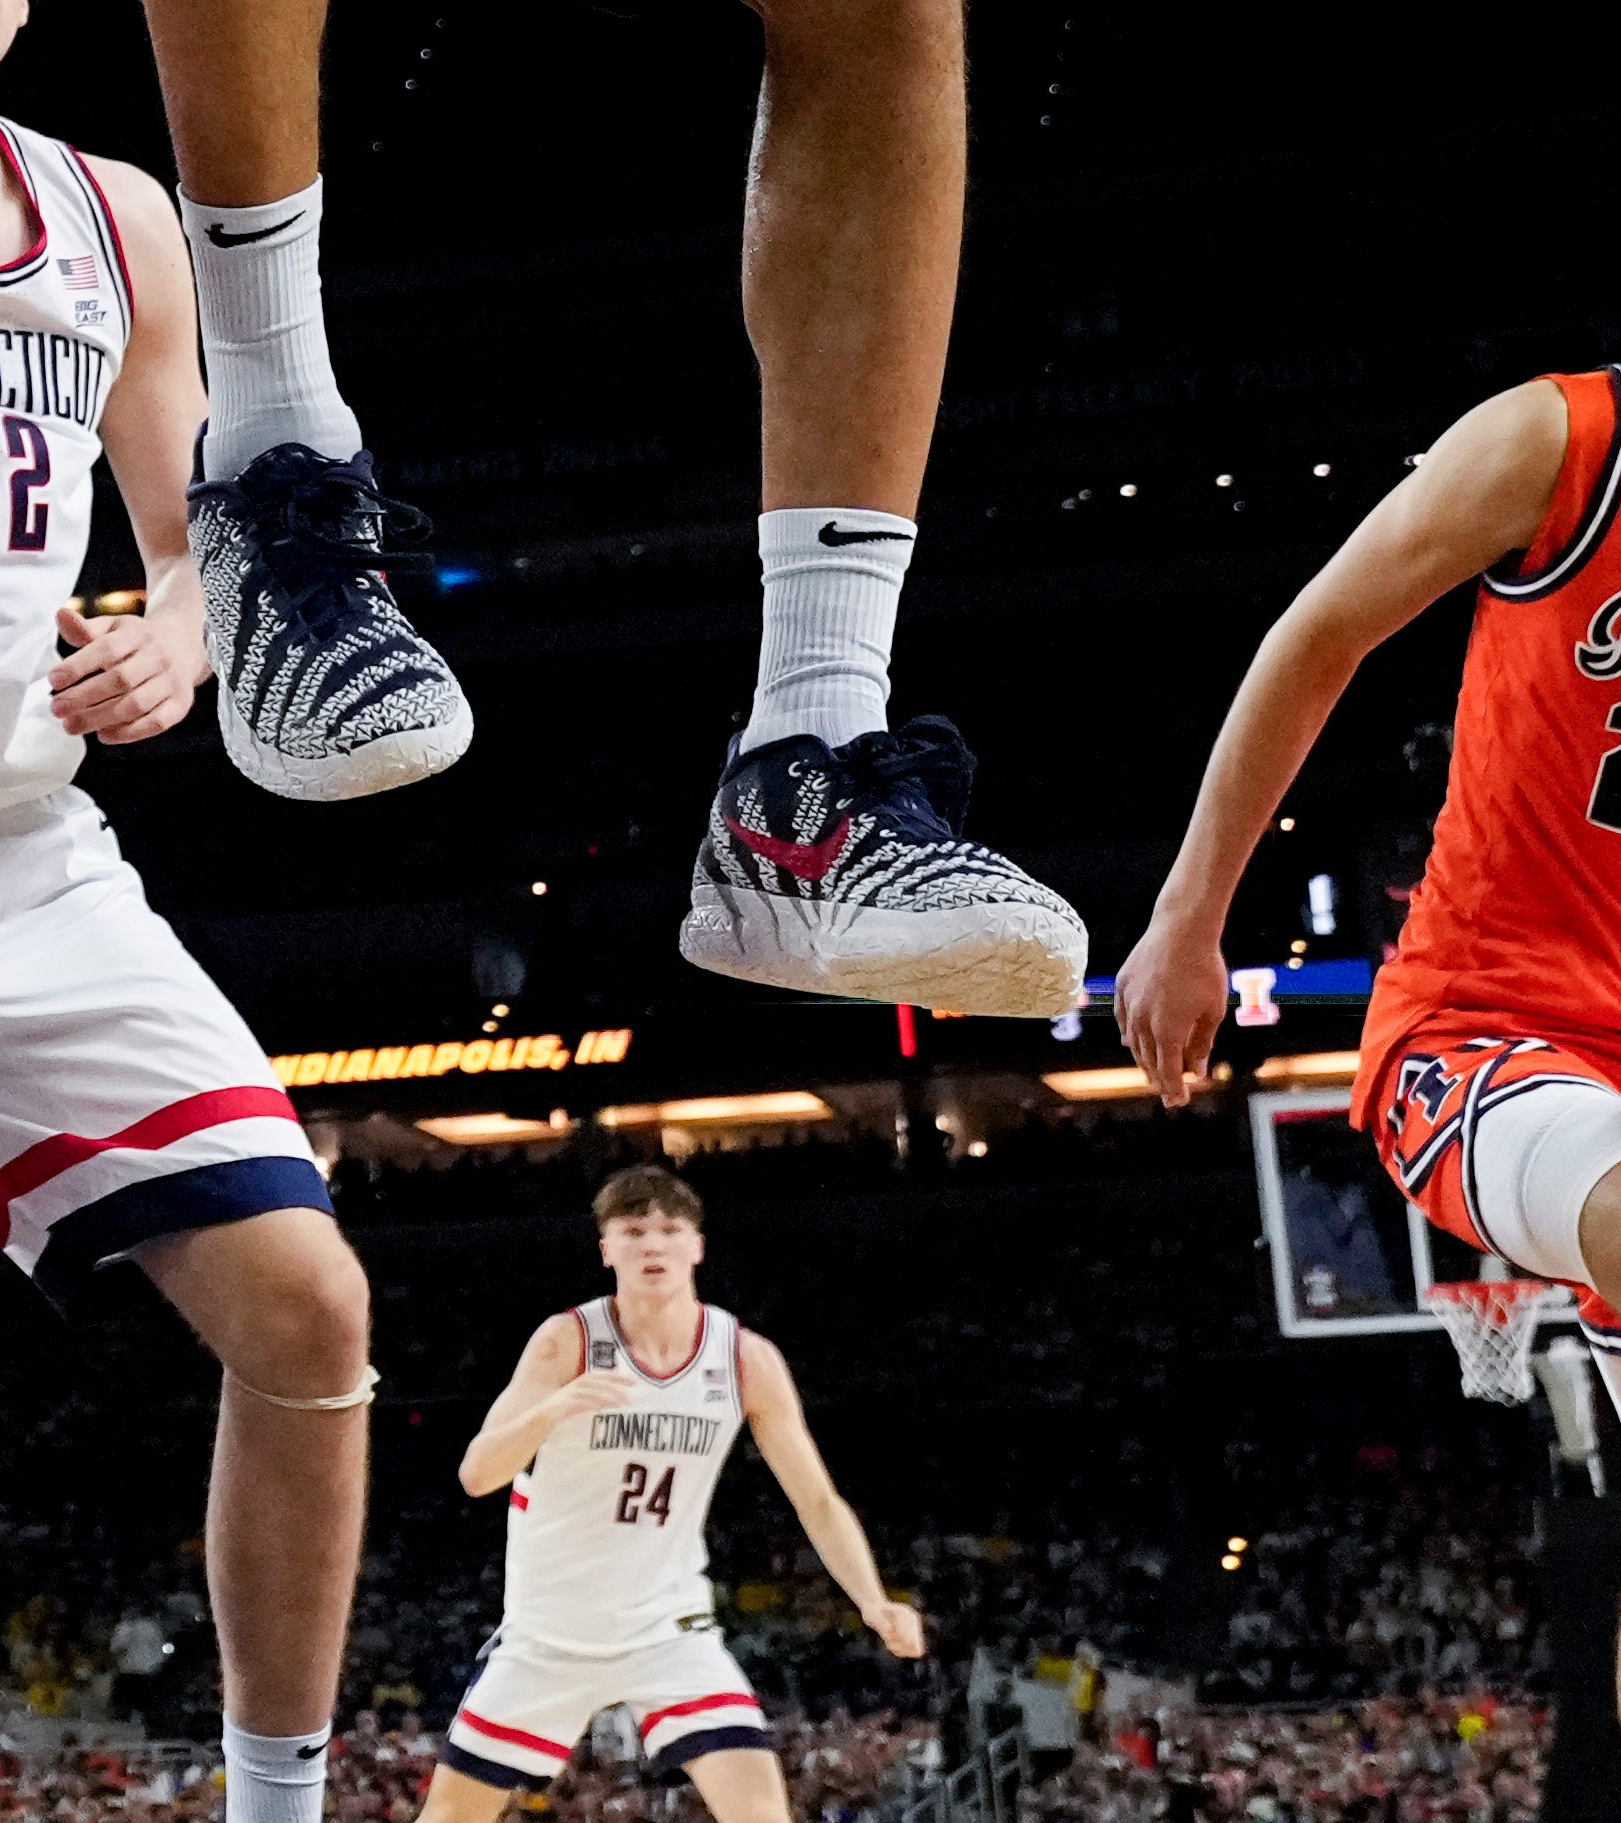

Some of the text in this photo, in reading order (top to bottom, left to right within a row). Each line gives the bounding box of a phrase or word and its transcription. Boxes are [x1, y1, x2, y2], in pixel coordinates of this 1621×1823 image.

[269, 1028, 633, 1087] NDIANAPOLIS, IN
[589, 1412, 722, 1457] CONNECTICUT
[615, 1462, 676, 1528] 24
